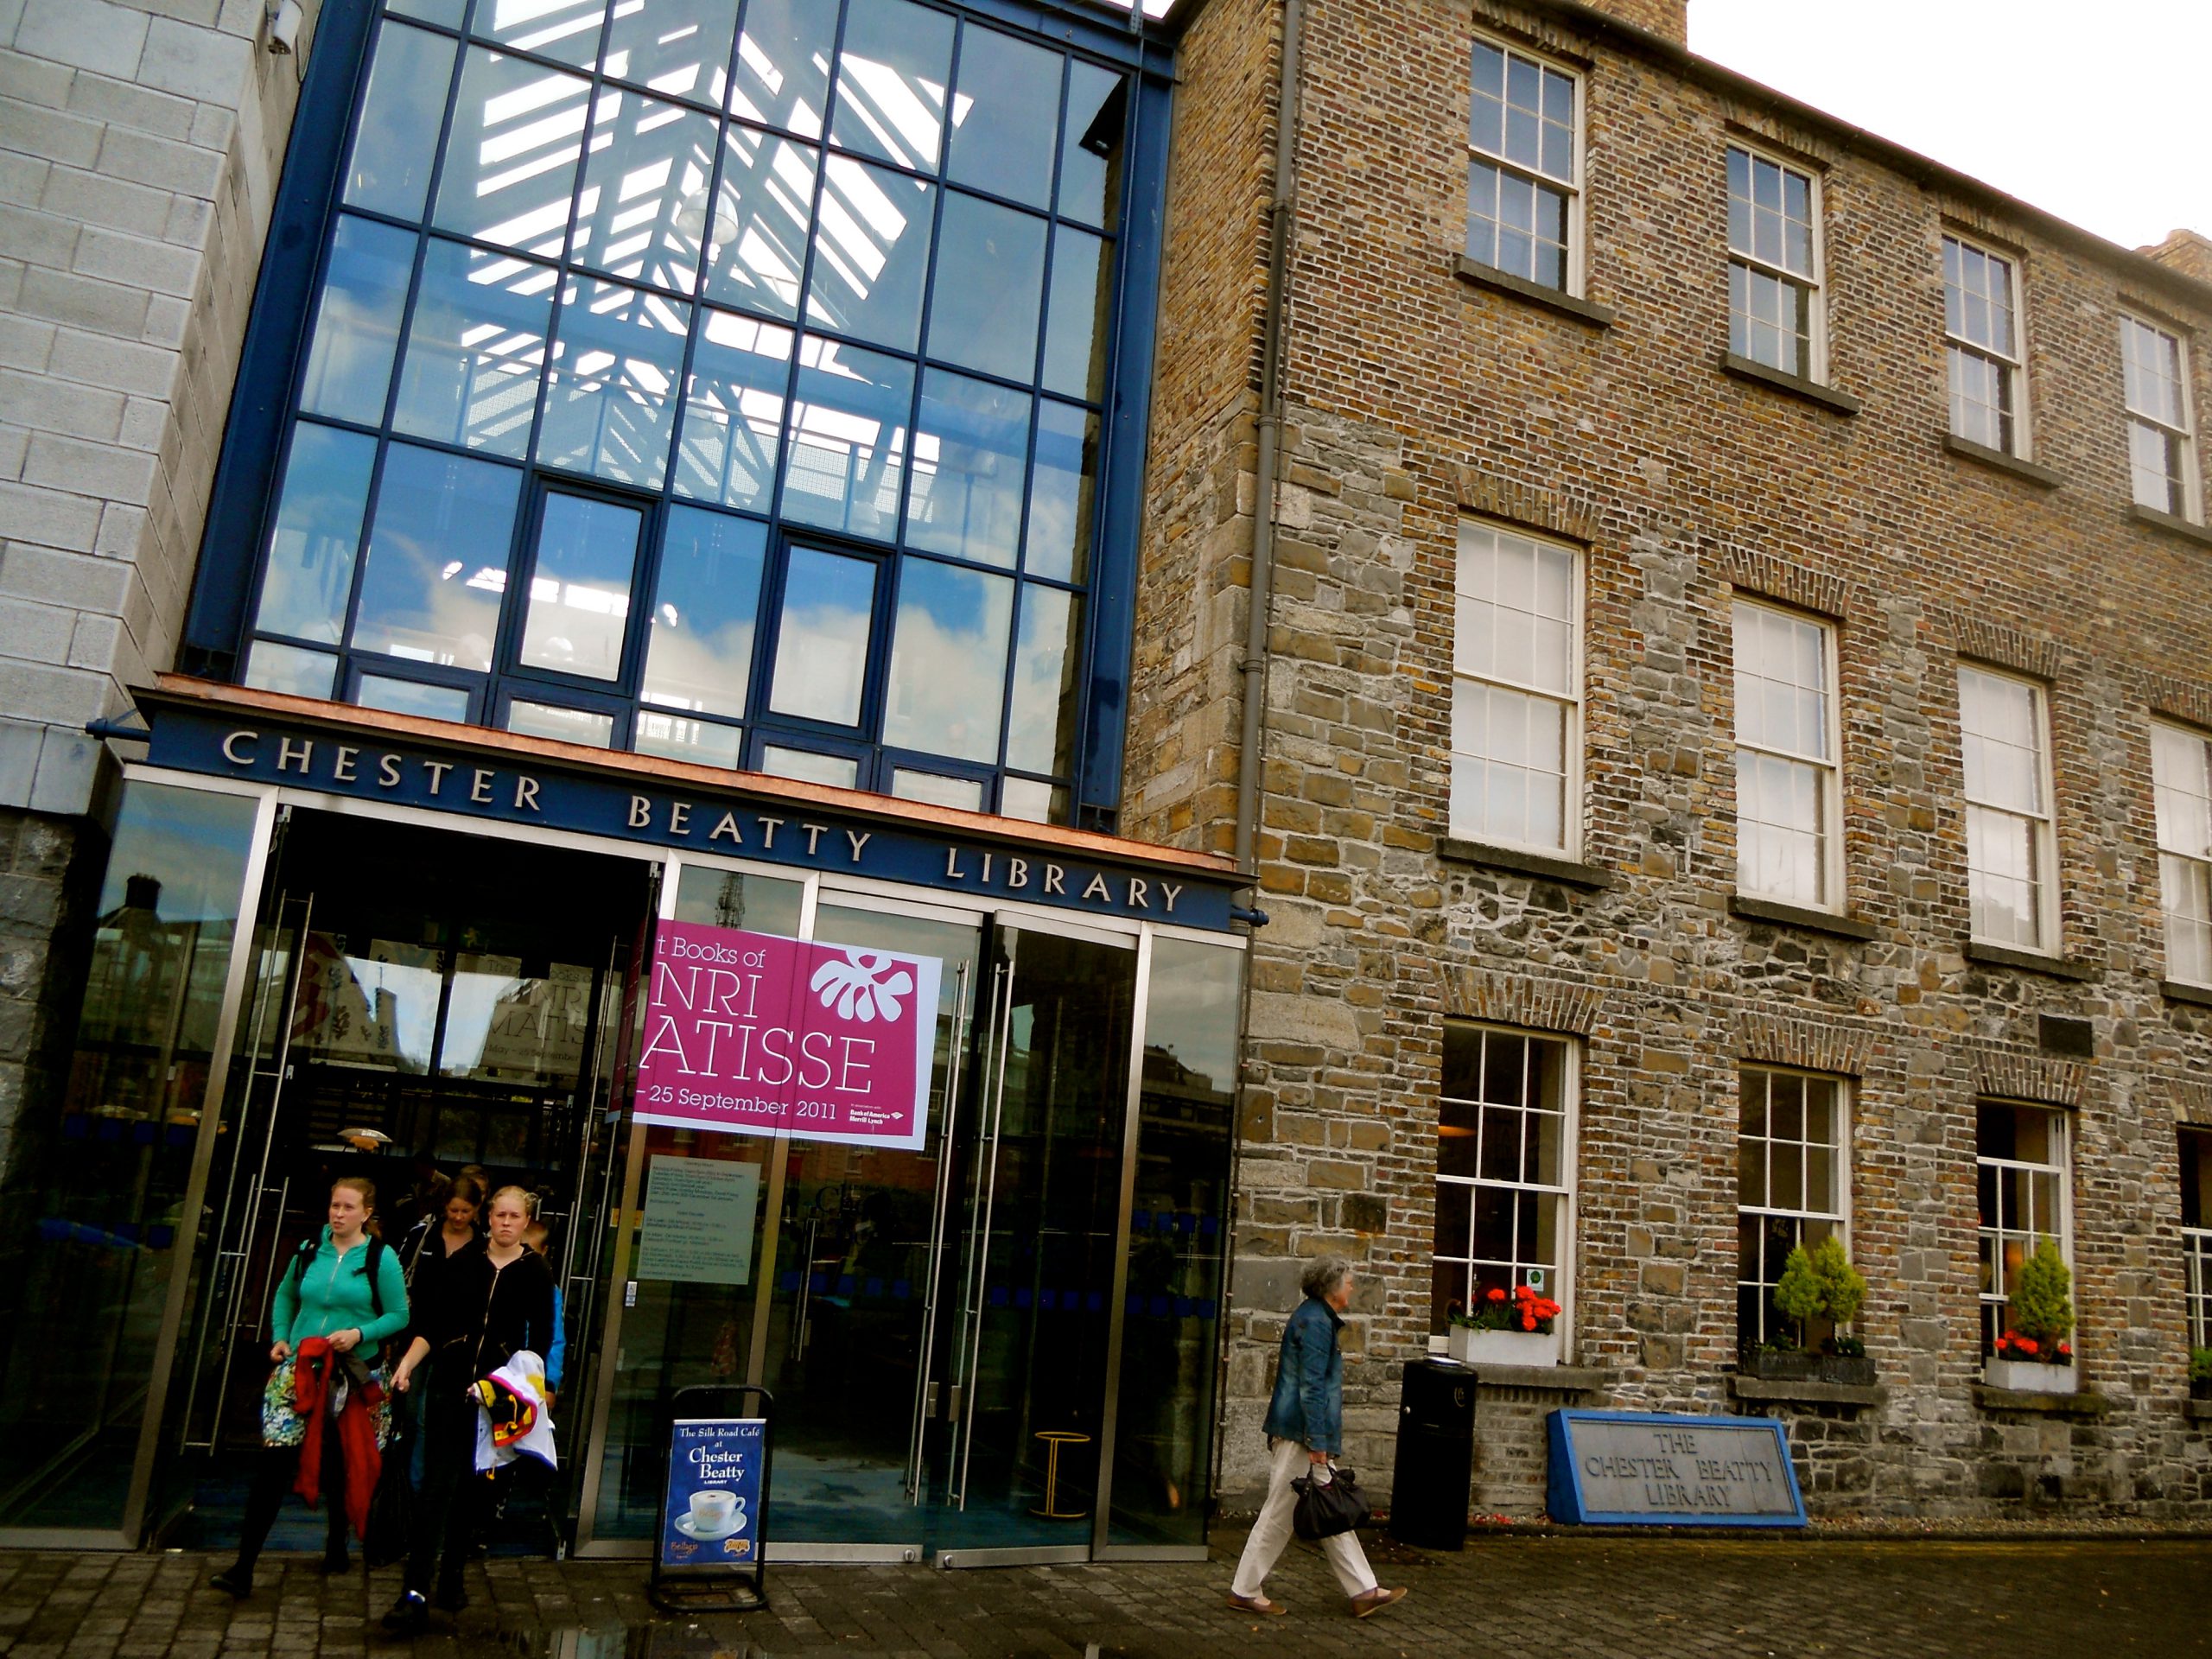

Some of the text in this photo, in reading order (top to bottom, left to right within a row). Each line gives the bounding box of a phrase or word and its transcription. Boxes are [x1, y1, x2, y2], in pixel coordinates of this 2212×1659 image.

[222, 730, 1183, 912] CHESTER BEATTY LIBRARY
[671, 938, 738, 963] Books
[743, 950, 766, 969] of
[652, 962, 763, 1018] NRI
[639, 1014, 875, 1094] ATISSE
[649, 1085, 674, 1104] 25
[678, 1089, 790, 1117] September
[796, 1100, 837, 1120] 2011
[680, 1427, 760, 1438] The Silk Road Café
[1653, 1433, 1698, 1454] THE
[689, 1446, 743, 1464] Chester
[700, 1464, 745, 1482] Beatty
[1585, 1456, 1772, 1482] CHESTER BEATTY
[1644, 1484, 1731, 1507] LIBRARY
